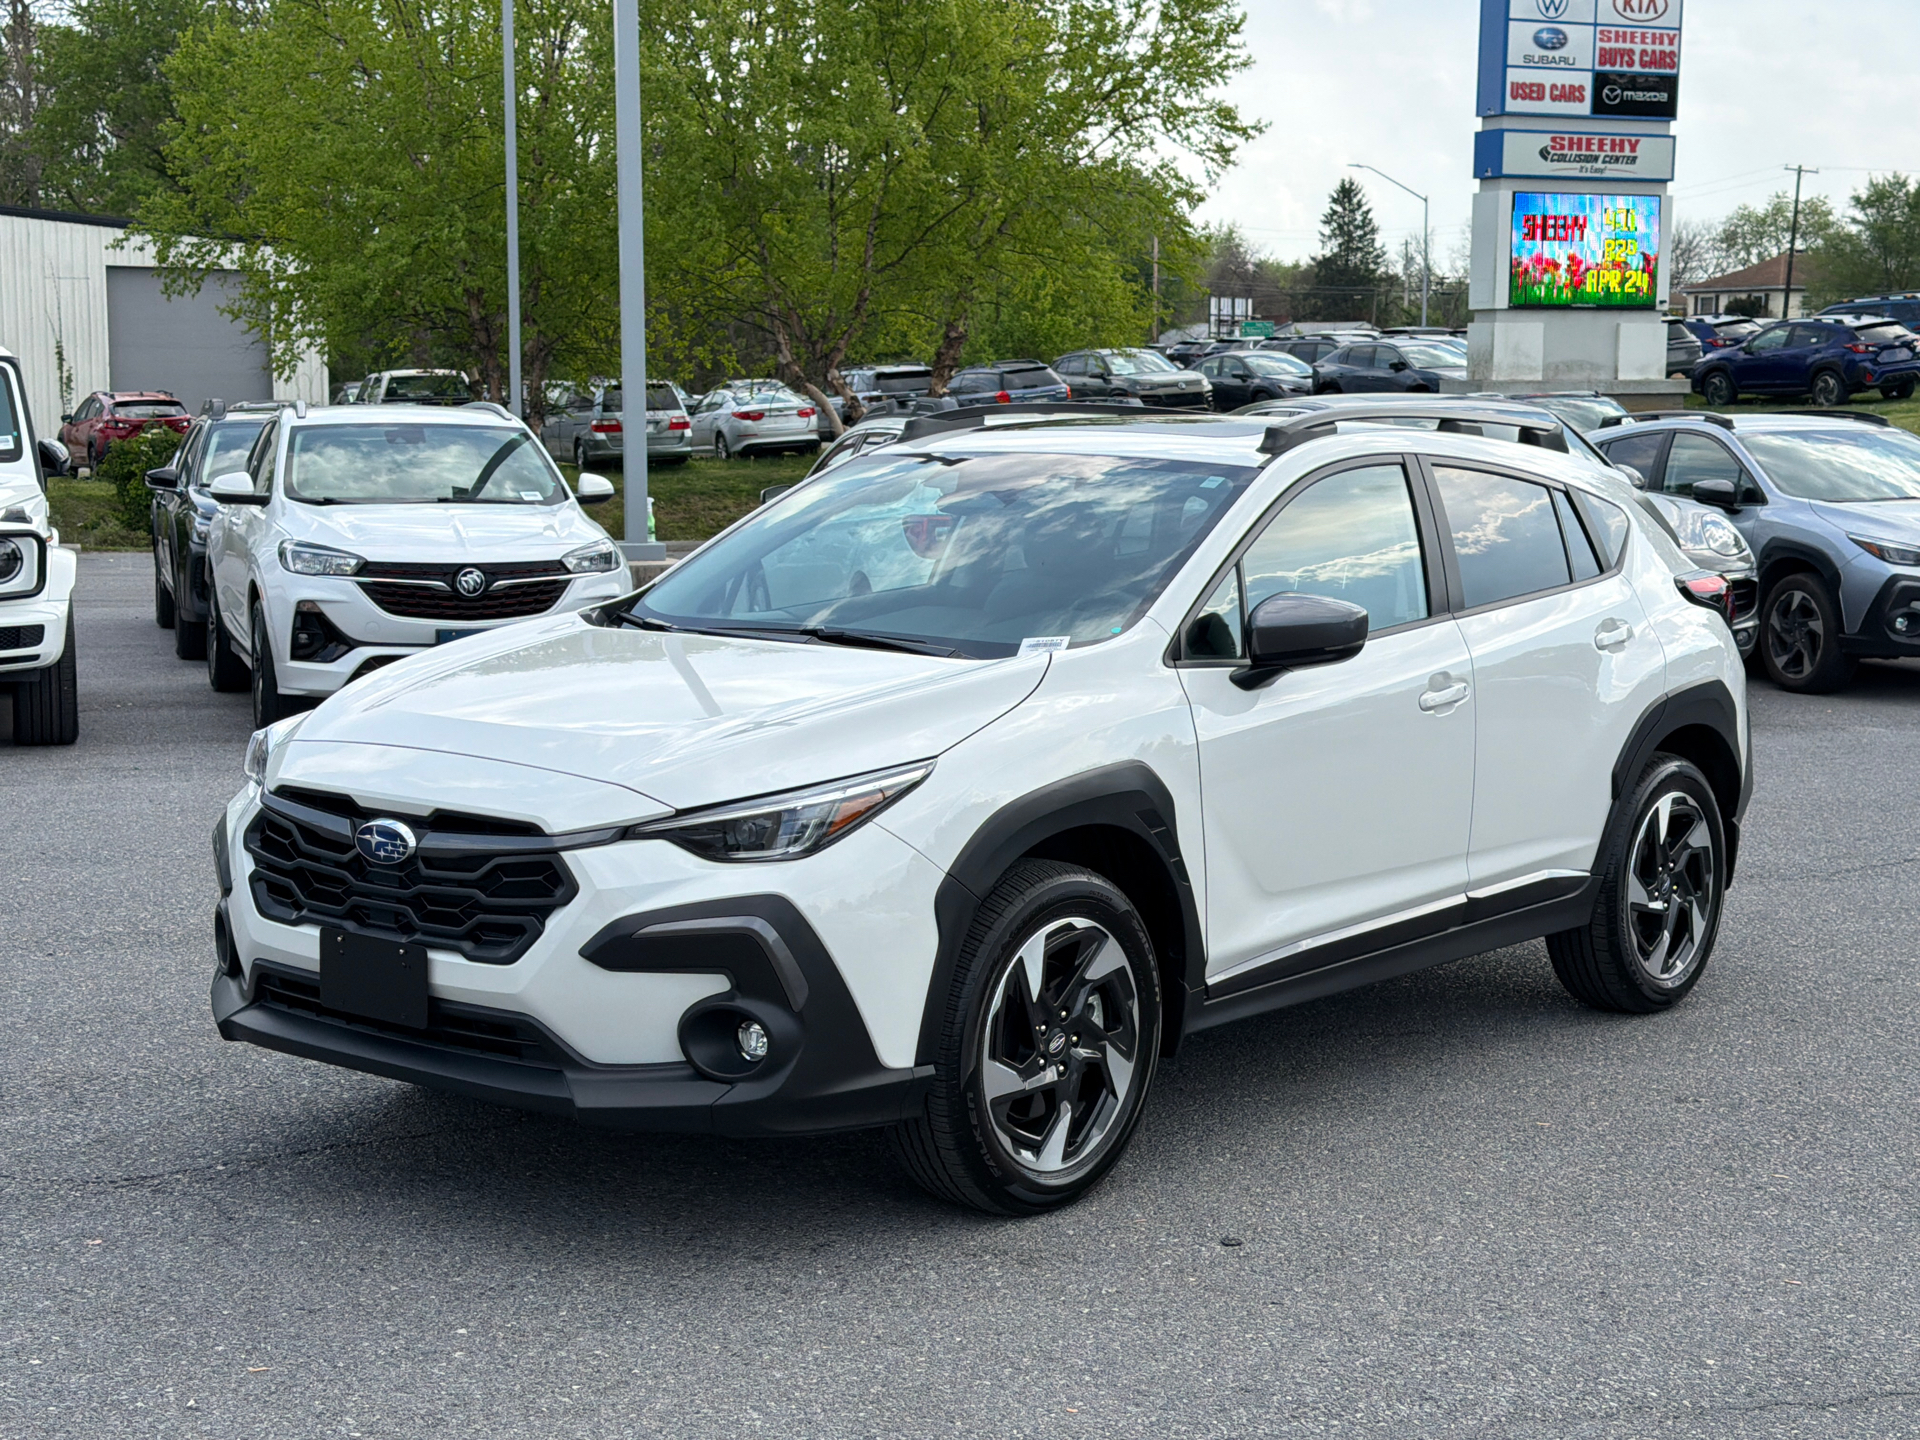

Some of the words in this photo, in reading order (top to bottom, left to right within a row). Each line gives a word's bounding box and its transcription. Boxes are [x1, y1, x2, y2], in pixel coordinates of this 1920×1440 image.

[1622, 0, 1659, 15] KIA
[1598, 29, 1678, 46] SHEEHY
[1522, 54, 1576, 66] SUBARU
[1598, 47, 1636, 68] BUYS
[1639, 48, 1677, 70] CARS
[1510, 82, 1546, 101] USED
[1549, 83, 1586, 103] CARS
[1622, 91, 1668, 103] mazda
[1550, 136, 1641, 154] SHEEHY
[1549, 152, 1599, 164] COLLISION
[1601, 154, 1638, 165] CENTER
[1578, 165, 1589, 174] It's
[1522, 214, 1588, 242] SHEEHY
[1586, 269, 1622, 293] APR
[1624, 270, 1649, 293] 24
